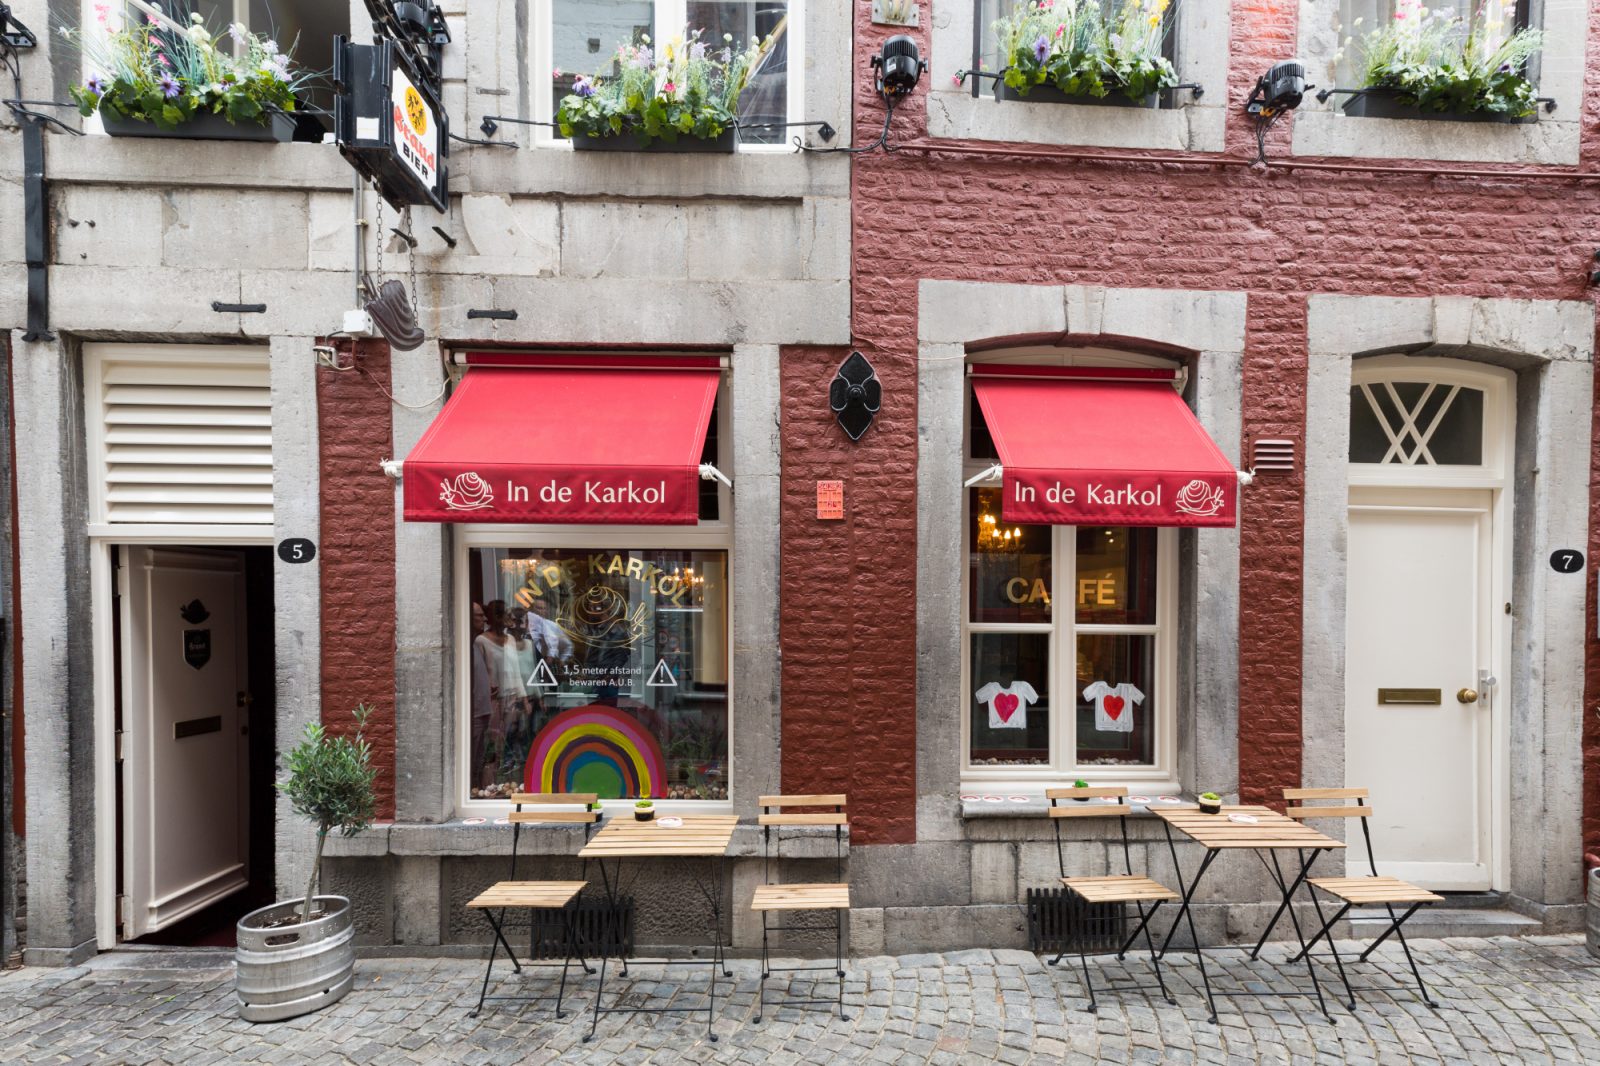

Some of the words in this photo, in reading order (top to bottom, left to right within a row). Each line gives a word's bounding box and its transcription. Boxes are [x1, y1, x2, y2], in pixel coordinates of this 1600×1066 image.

[394, 105, 435, 172] Brand
[403, 142, 428, 180] BIER
[507, 480, 529, 502] In
[540, 481, 572, 503] de
[585, 481, 666, 504] Karkol
[1015, 481, 1036, 502] In
[1046, 481, 1076, 504] de
[1087, 484, 1161, 506] Karkol
[292, 543, 303, 559] 5
[1562, 555, 1574, 570] 7
[514, 579, 543, 608] IN
[543, 558, 580, 588] DE
[587, 553, 687, 608] KARKOL
[563, 664, 580, 676] 1,5
[582, 666, 607, 675] meter
[609, 665, 642, 675] afstand
[569, 677, 607, 687] bewaren
